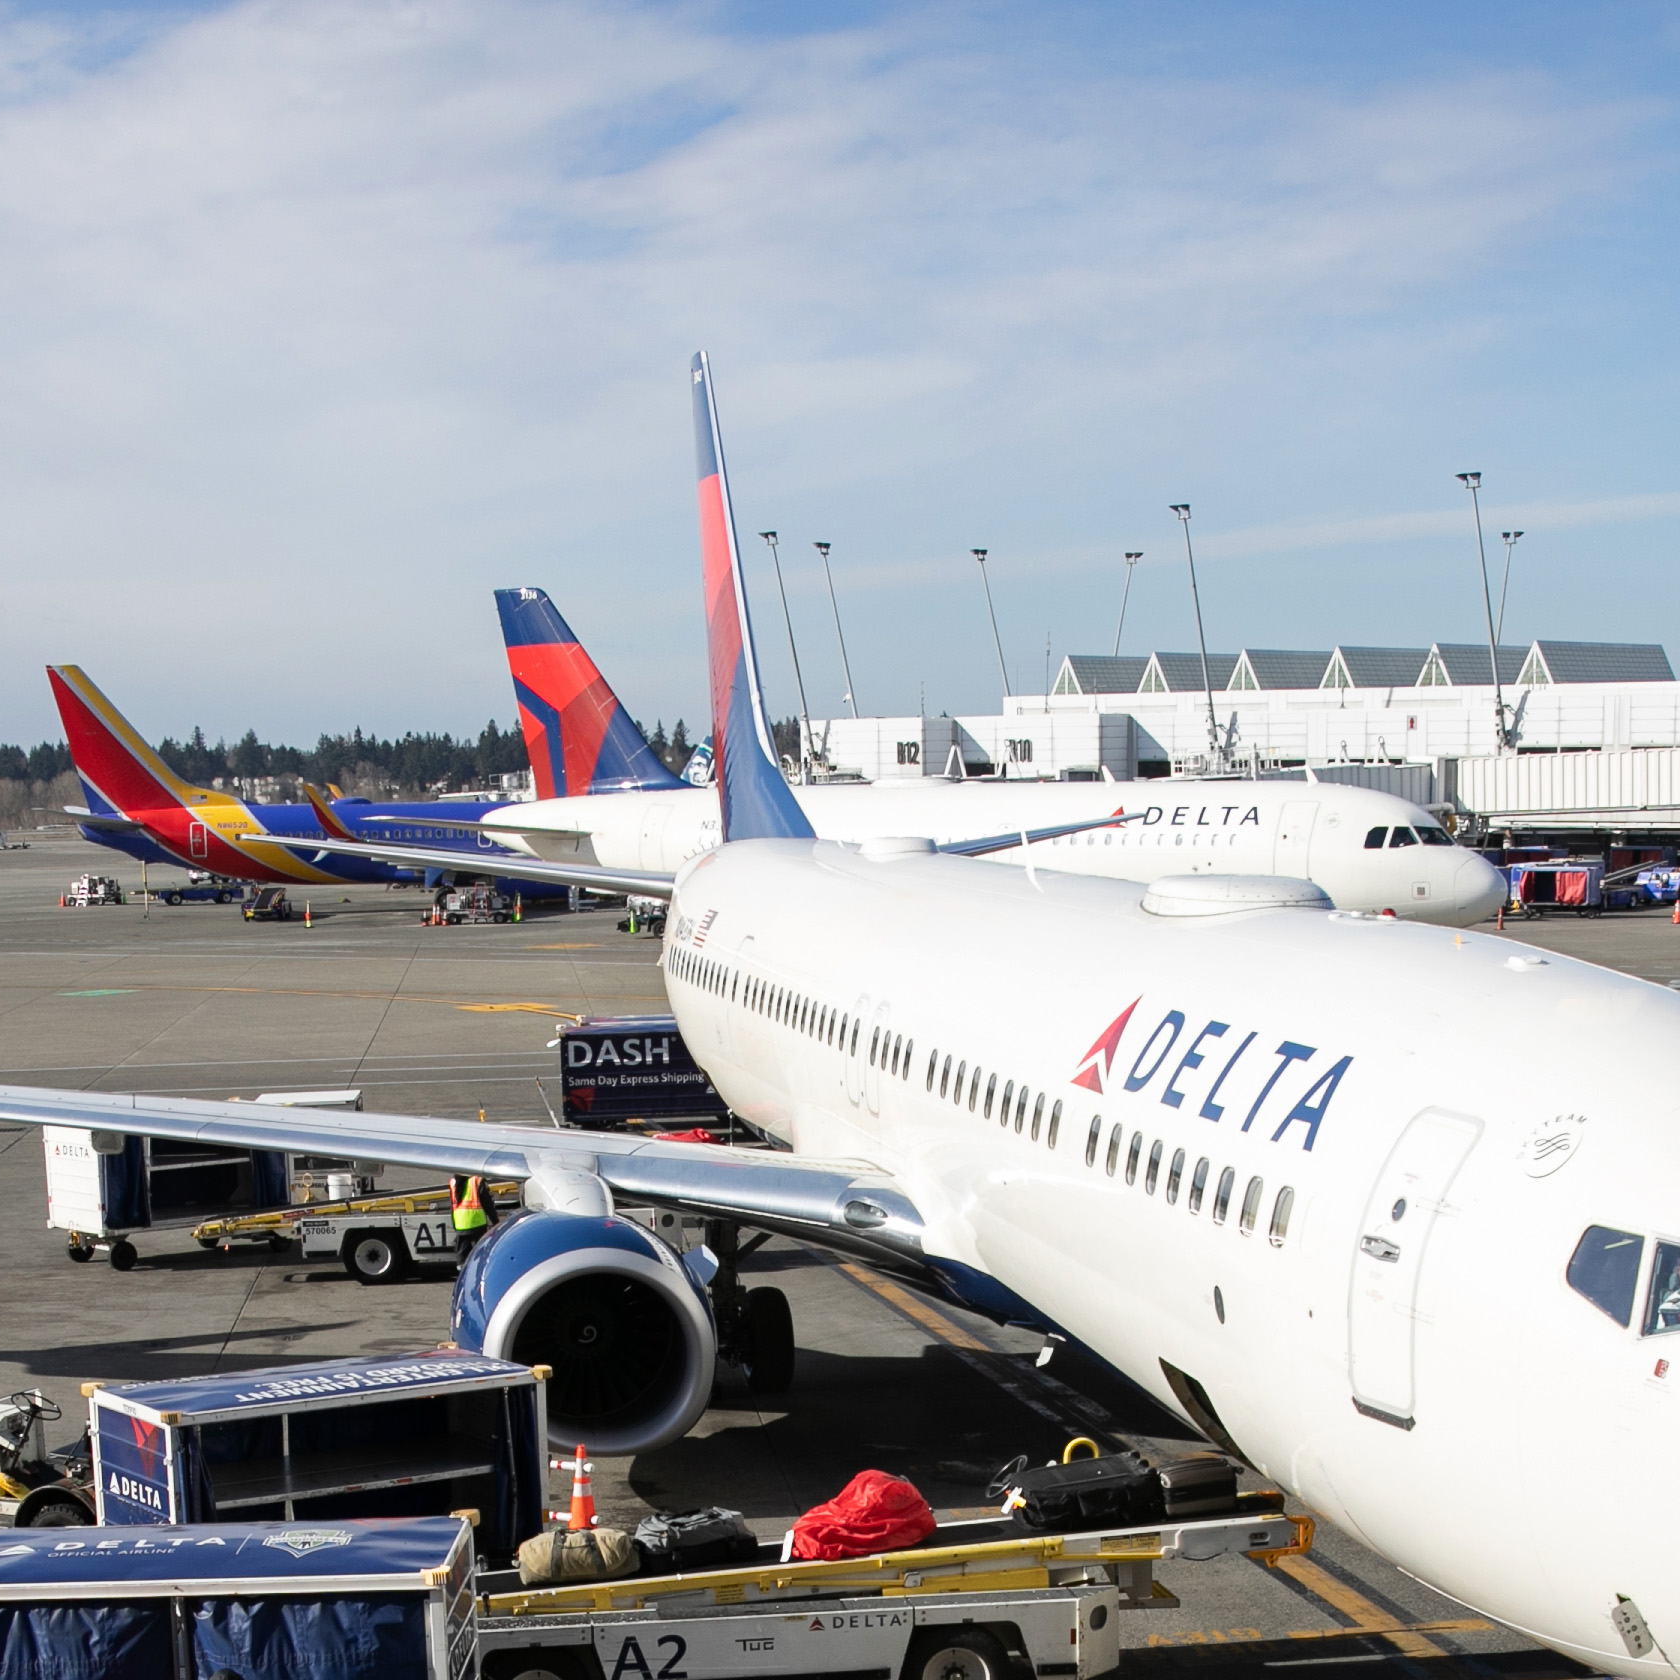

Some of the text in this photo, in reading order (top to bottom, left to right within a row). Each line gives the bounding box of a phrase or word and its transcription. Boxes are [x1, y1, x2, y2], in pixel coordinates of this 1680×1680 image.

[897, 742, 920, 764] B12
[1142, 806, 1260, 826] DELTA
[568, 1072, 705, 1087] Same Day Express Shipping
[1123, 1009, 1355, 1152] DELTA
[62, 1144, 91, 1160] DELTA
[305, 1226, 337, 1236] 570065
[414, 1222, 447, 1249] A1
[121, 1478, 162, 1510] DELTA
[53, 1537, 226, 1551] DELTA
[46, 1548, 175, 1559] OFFICIAL AIRLINE
[832, 1614, 903, 1630] DELTA
[735, 1637, 775, 1652] TUG
